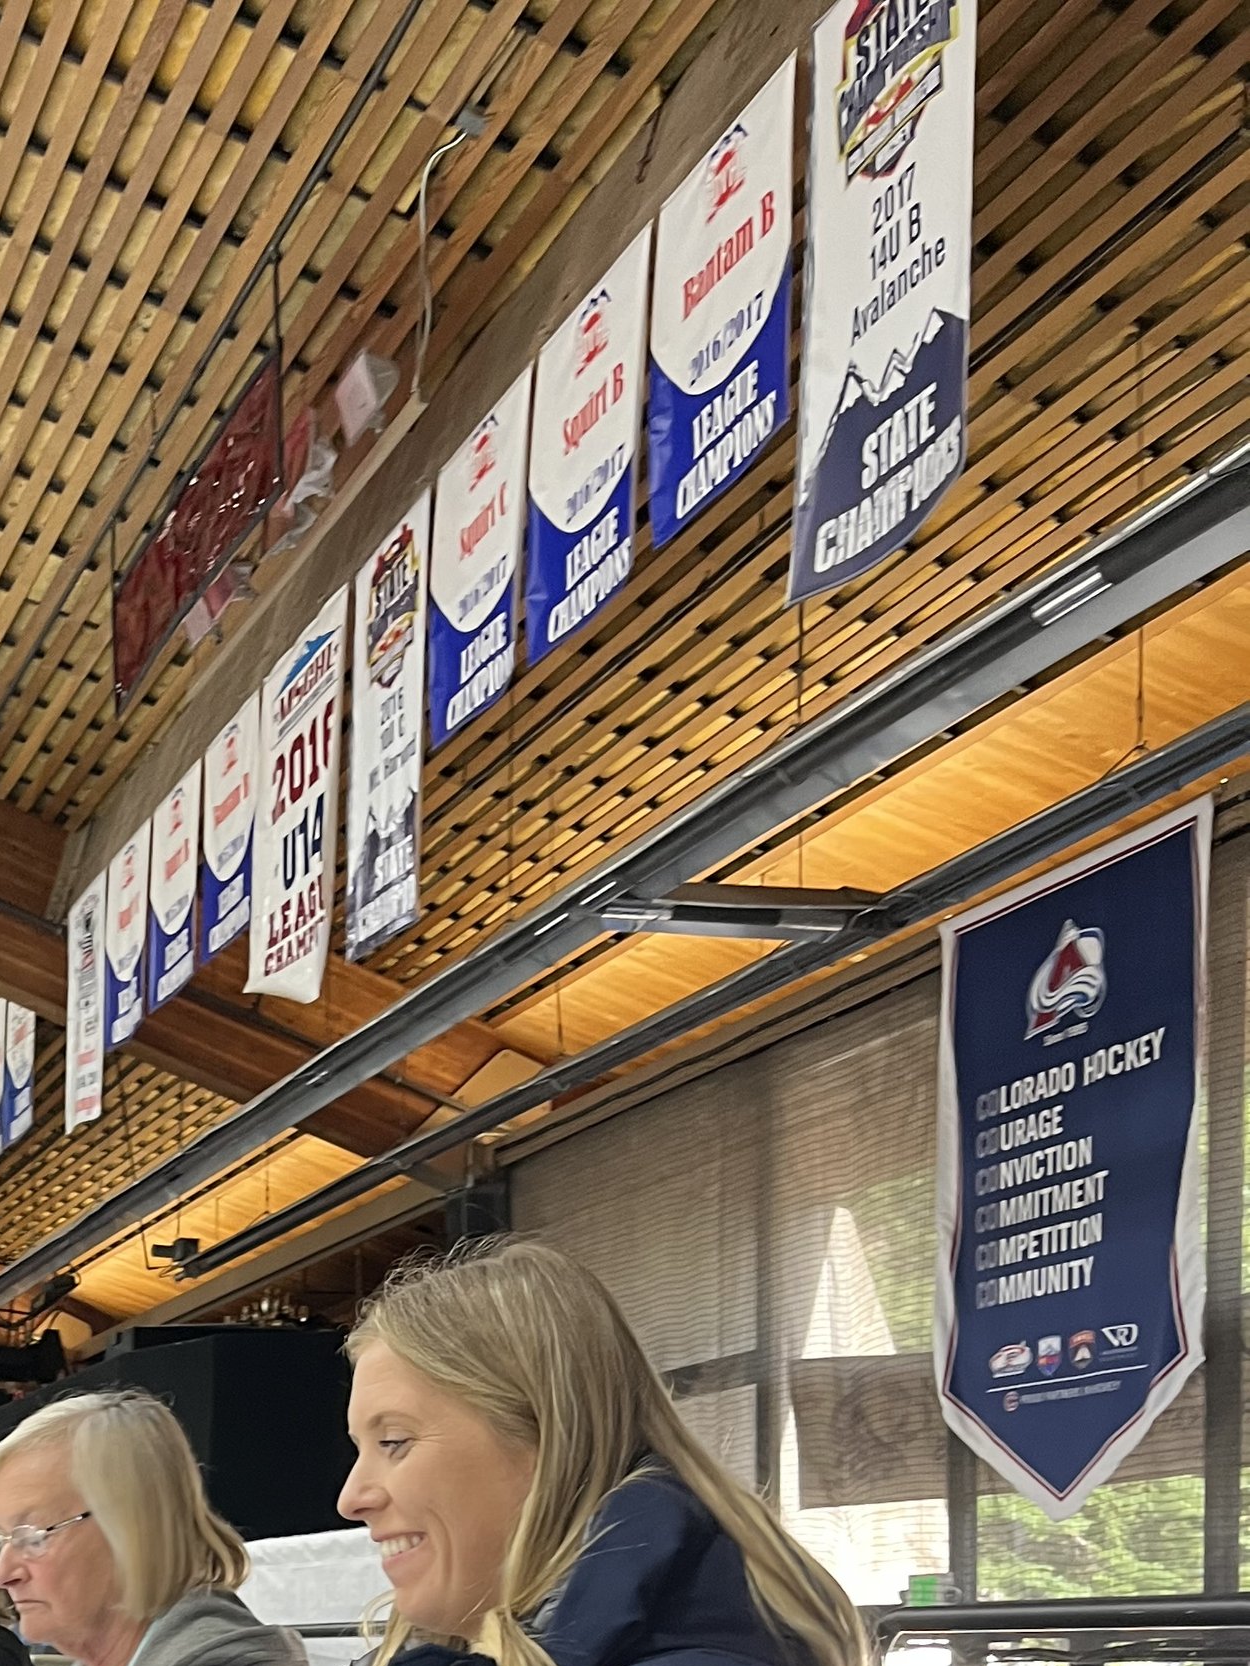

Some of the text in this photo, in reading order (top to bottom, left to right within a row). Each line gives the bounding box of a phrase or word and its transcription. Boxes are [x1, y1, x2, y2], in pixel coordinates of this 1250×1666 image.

[869, 202, 922, 281] 14U B
[872, 161, 916, 236] 2017
[682, 190, 775, 322] Bantam B
[851, 237, 945, 348] Avalanche
[611, 362, 624, 406] B
[692, 359, 758, 460] LEAGUE
[676, 390, 776, 519] CHAMPIONS
[861, 382, 937, 490] STATE
[814, 414, 961, 573] CHAMPIONS
[547, 536, 631, 643] CHAMPIONS
[565, 506, 619, 591] LEAGUE
[460, 611, 507, 685] LEAGUE
[282, 792, 325, 890] U14
[1083, 1026, 1166, 1087] HOCKEY
